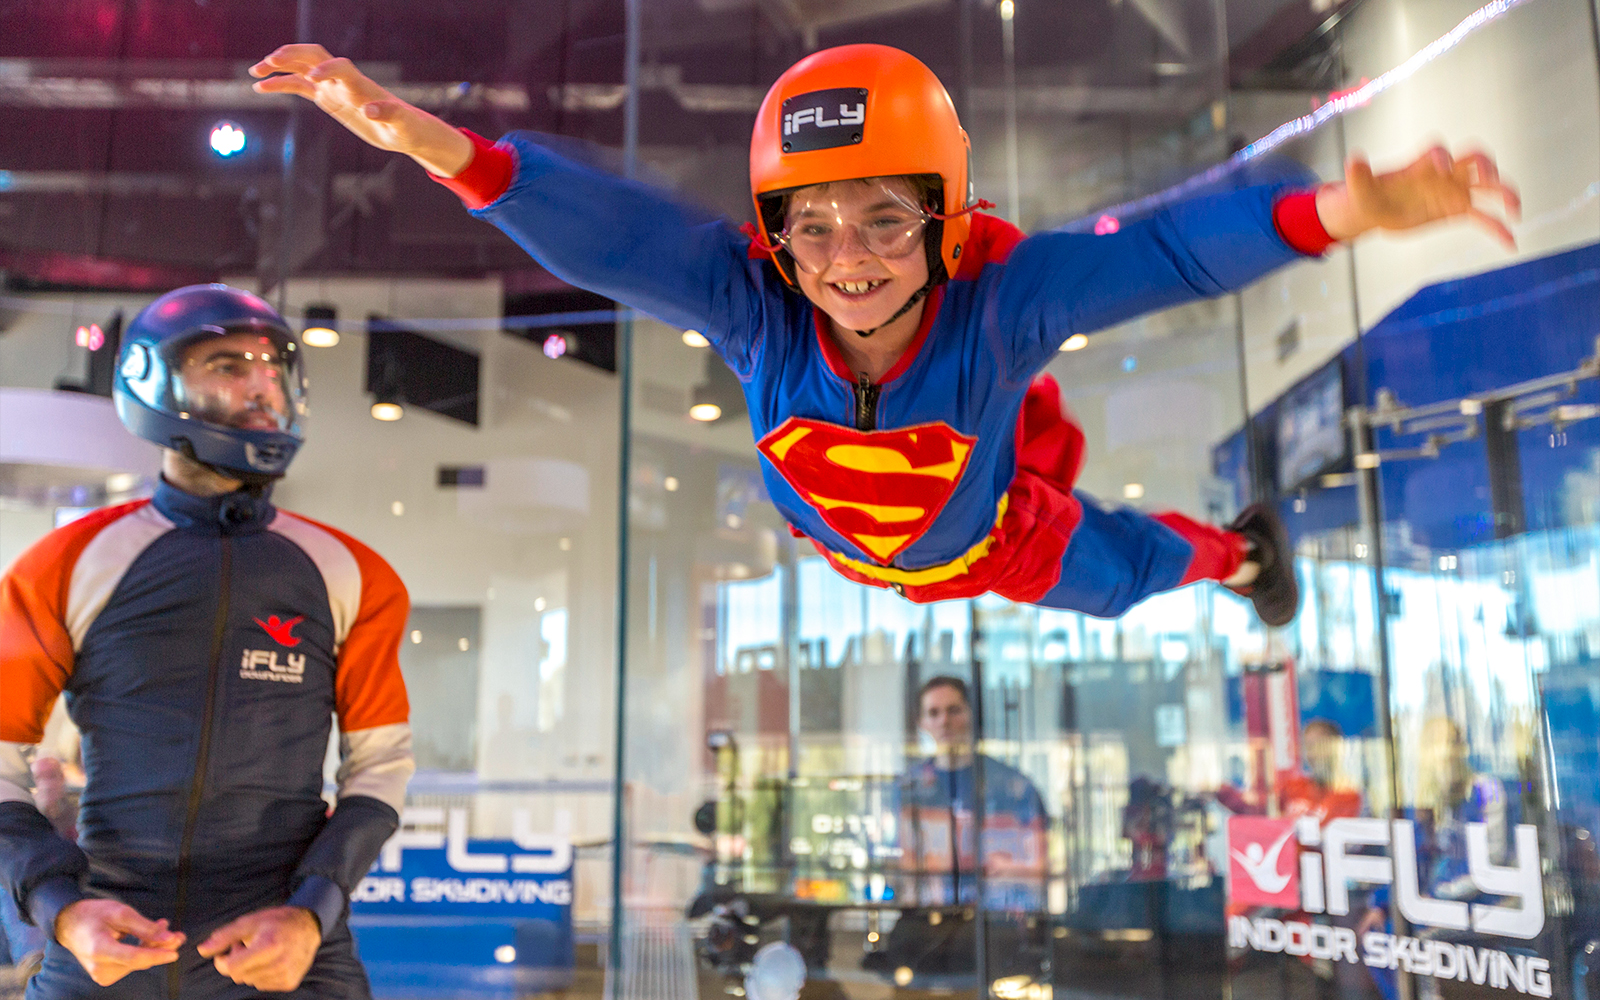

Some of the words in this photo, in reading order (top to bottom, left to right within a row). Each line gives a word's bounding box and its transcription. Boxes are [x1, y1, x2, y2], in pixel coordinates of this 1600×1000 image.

[784, 103, 865, 136] iFLY
[241, 648, 306, 674] iFLY
[369, 807, 574, 874] FLY
[410, 876, 573, 905] SKYDIVING
[1296, 815, 1546, 941] iFLY
[1227, 915, 1359, 965] INDOOR
[1362, 930, 1553, 999] SKYDIVING
